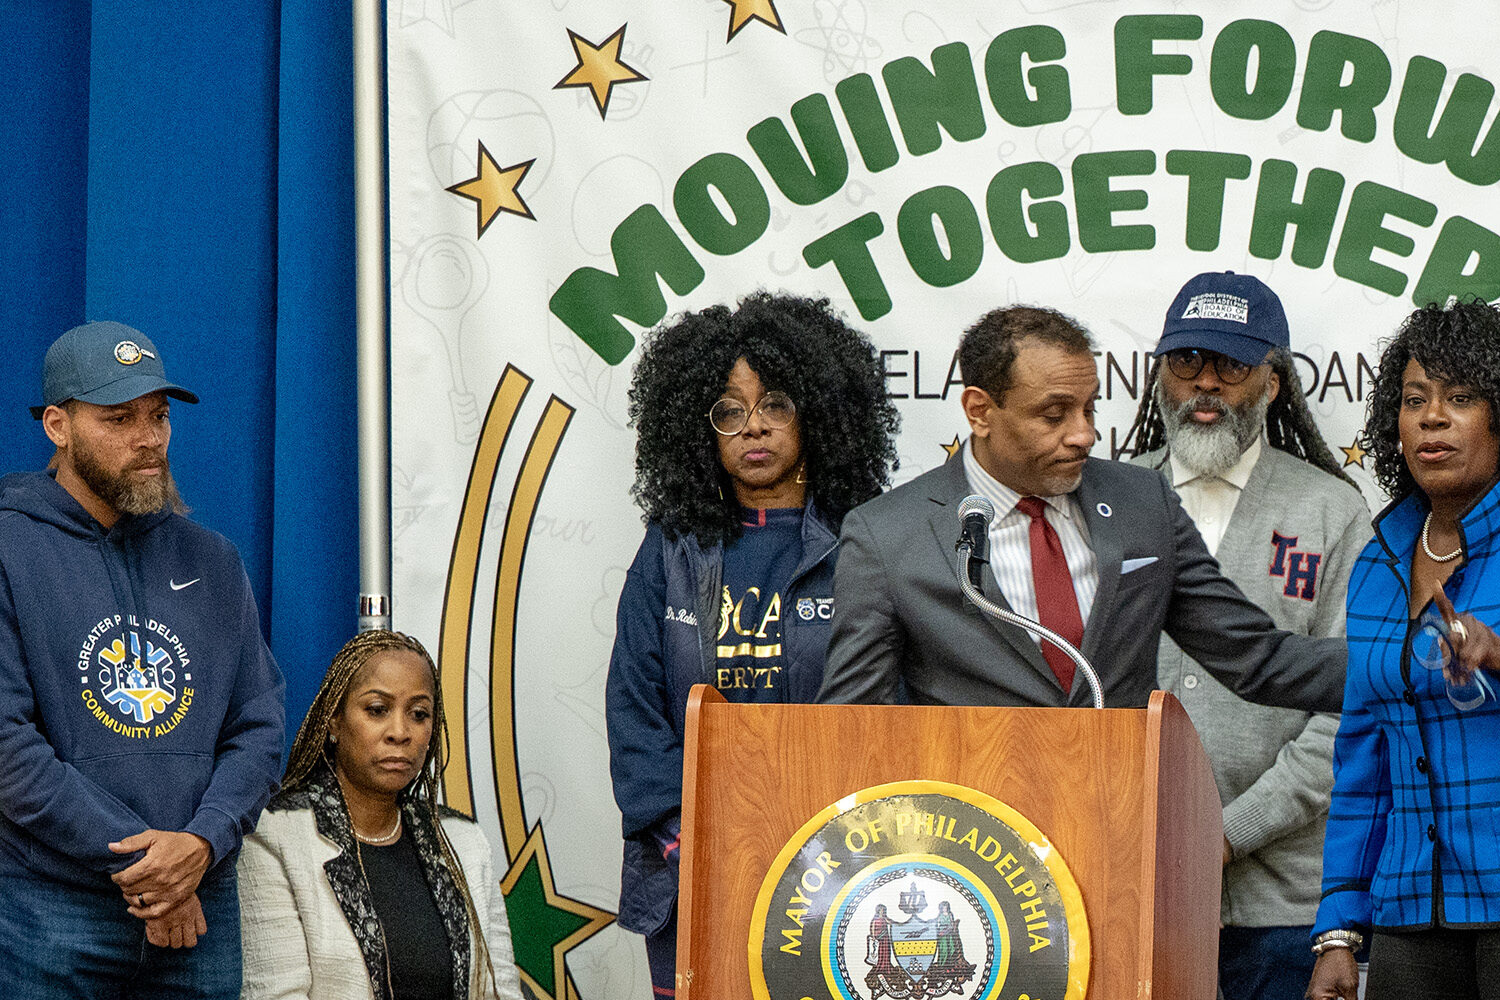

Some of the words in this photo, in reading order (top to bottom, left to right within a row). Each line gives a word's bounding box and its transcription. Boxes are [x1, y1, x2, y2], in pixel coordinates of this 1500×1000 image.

[550, 24, 1072, 367] MOVING
[1203, 310, 1246, 322] EDUCATION
[1204, 304, 1232, 313] BOARD
[1235, 307, 1246, 315] OF
[1269, 529, 1322, 602] TH
[77, 616, 115, 671] GREATER
[113, 613, 191, 668] PILDELPHIA
[81, 689, 152, 739] COMMUNITY
[154, 686, 195, 737] ALLIANCE
[779, 850, 842, 957] MAYOR
[844, 818, 885, 854] OF
[896, 812, 1051, 954] PHILADELPHIA
